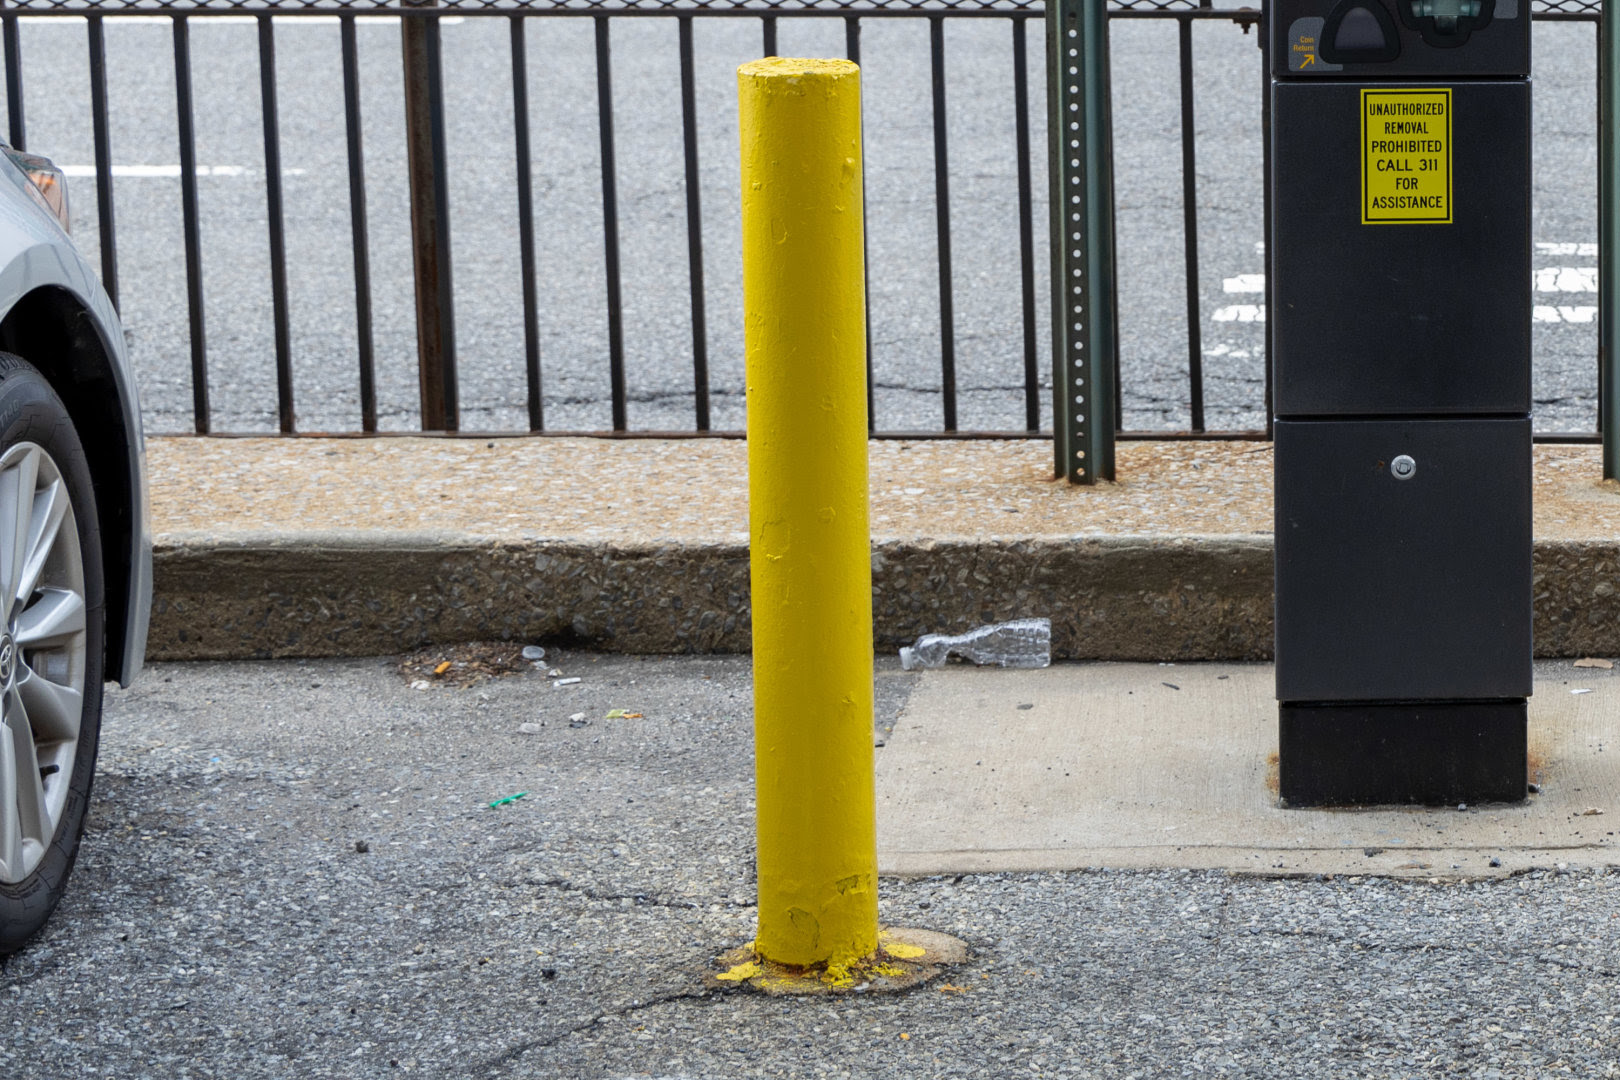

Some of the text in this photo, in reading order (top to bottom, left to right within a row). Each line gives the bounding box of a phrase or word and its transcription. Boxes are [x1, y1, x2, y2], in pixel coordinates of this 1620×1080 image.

[1369, 103, 1444, 115] UNAUTHORIZED
[1384, 122, 1429, 134] REMOVAL
[1371, 140, 1442, 153] PROHIBITED
[1376, 159, 1438, 171] CALL 311
[1396, 178, 1418, 190] FOR
[1372, 196, 1443, 209] ASSISTANCE
